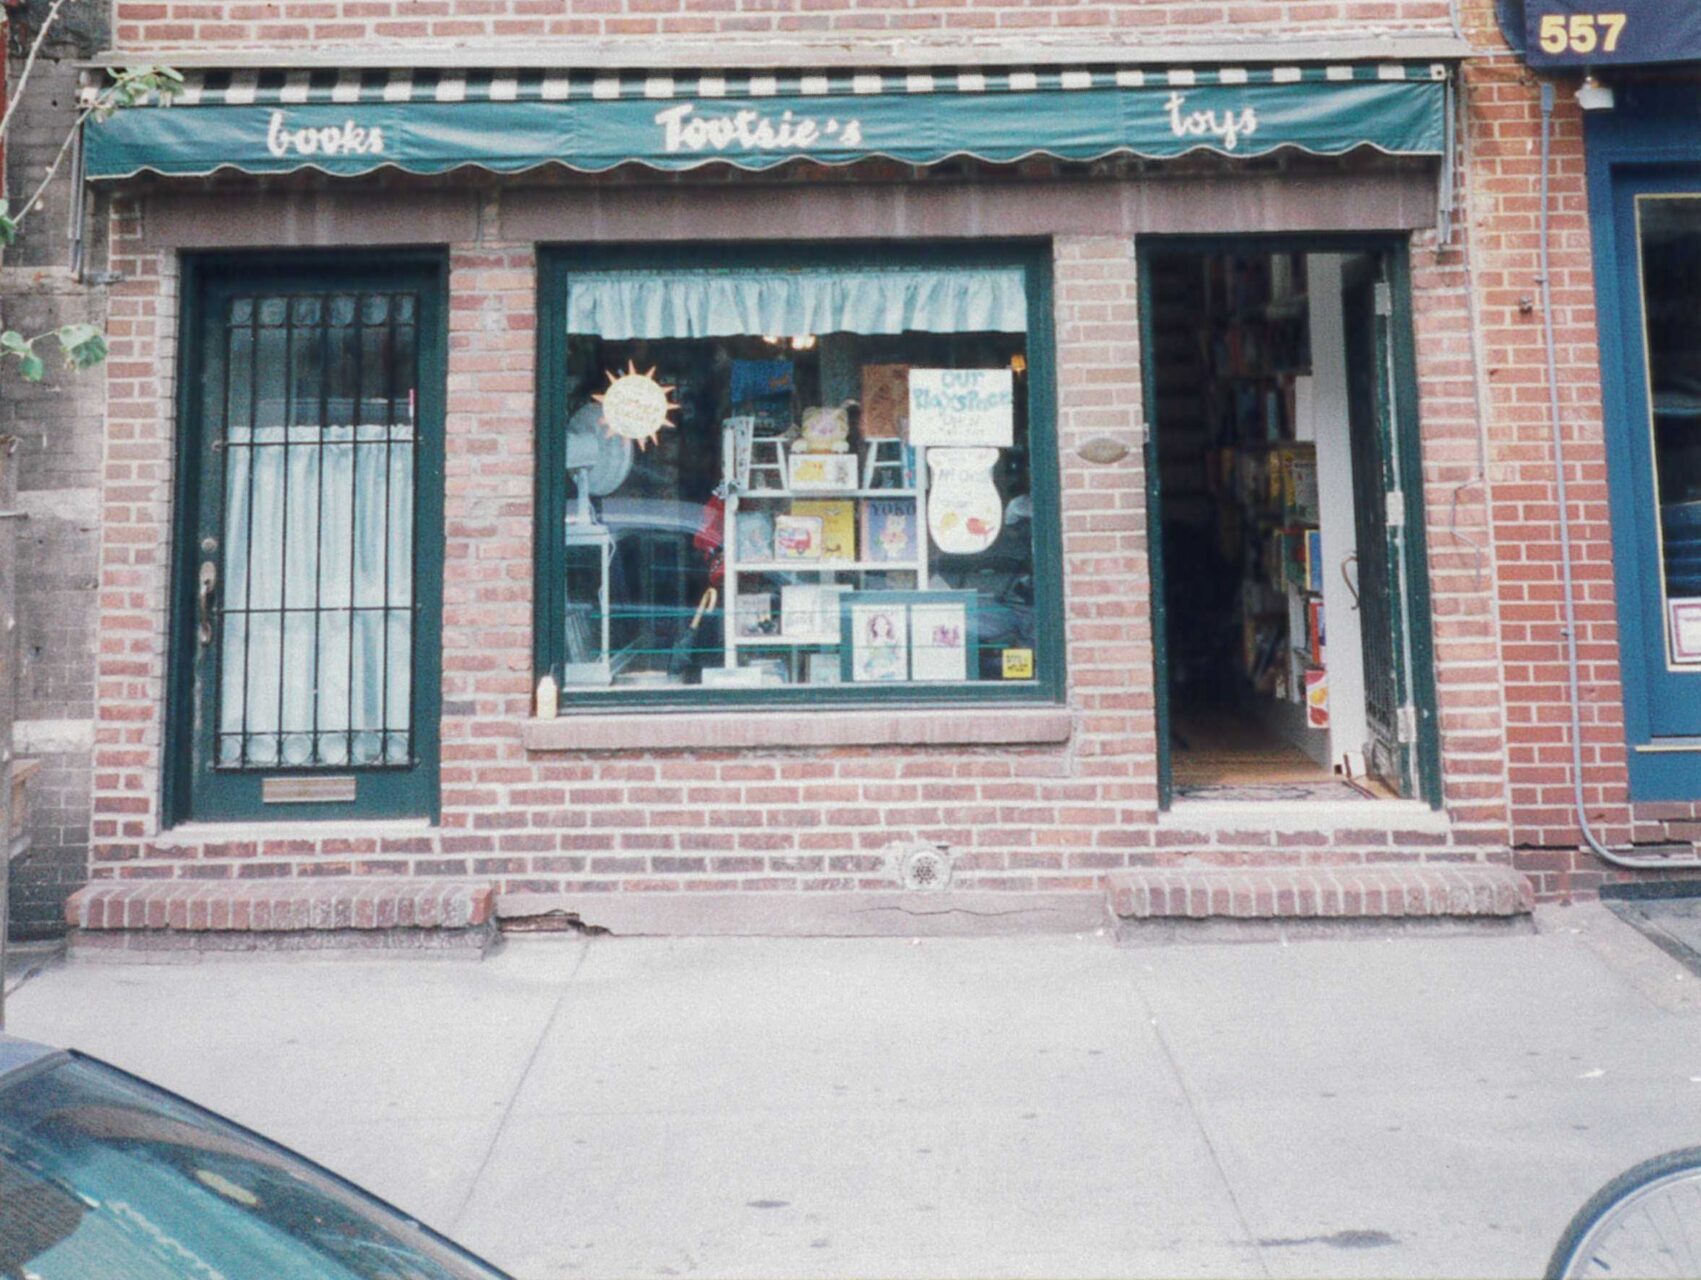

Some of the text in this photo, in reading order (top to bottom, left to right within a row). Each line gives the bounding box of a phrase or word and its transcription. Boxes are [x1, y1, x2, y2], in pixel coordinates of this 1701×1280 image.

[1539, 13, 1627, 54] 557
[267, 109, 384, 157] books
[654, 103, 862, 152] Tootsie's
[1163, 90, 1257, 151] toys
